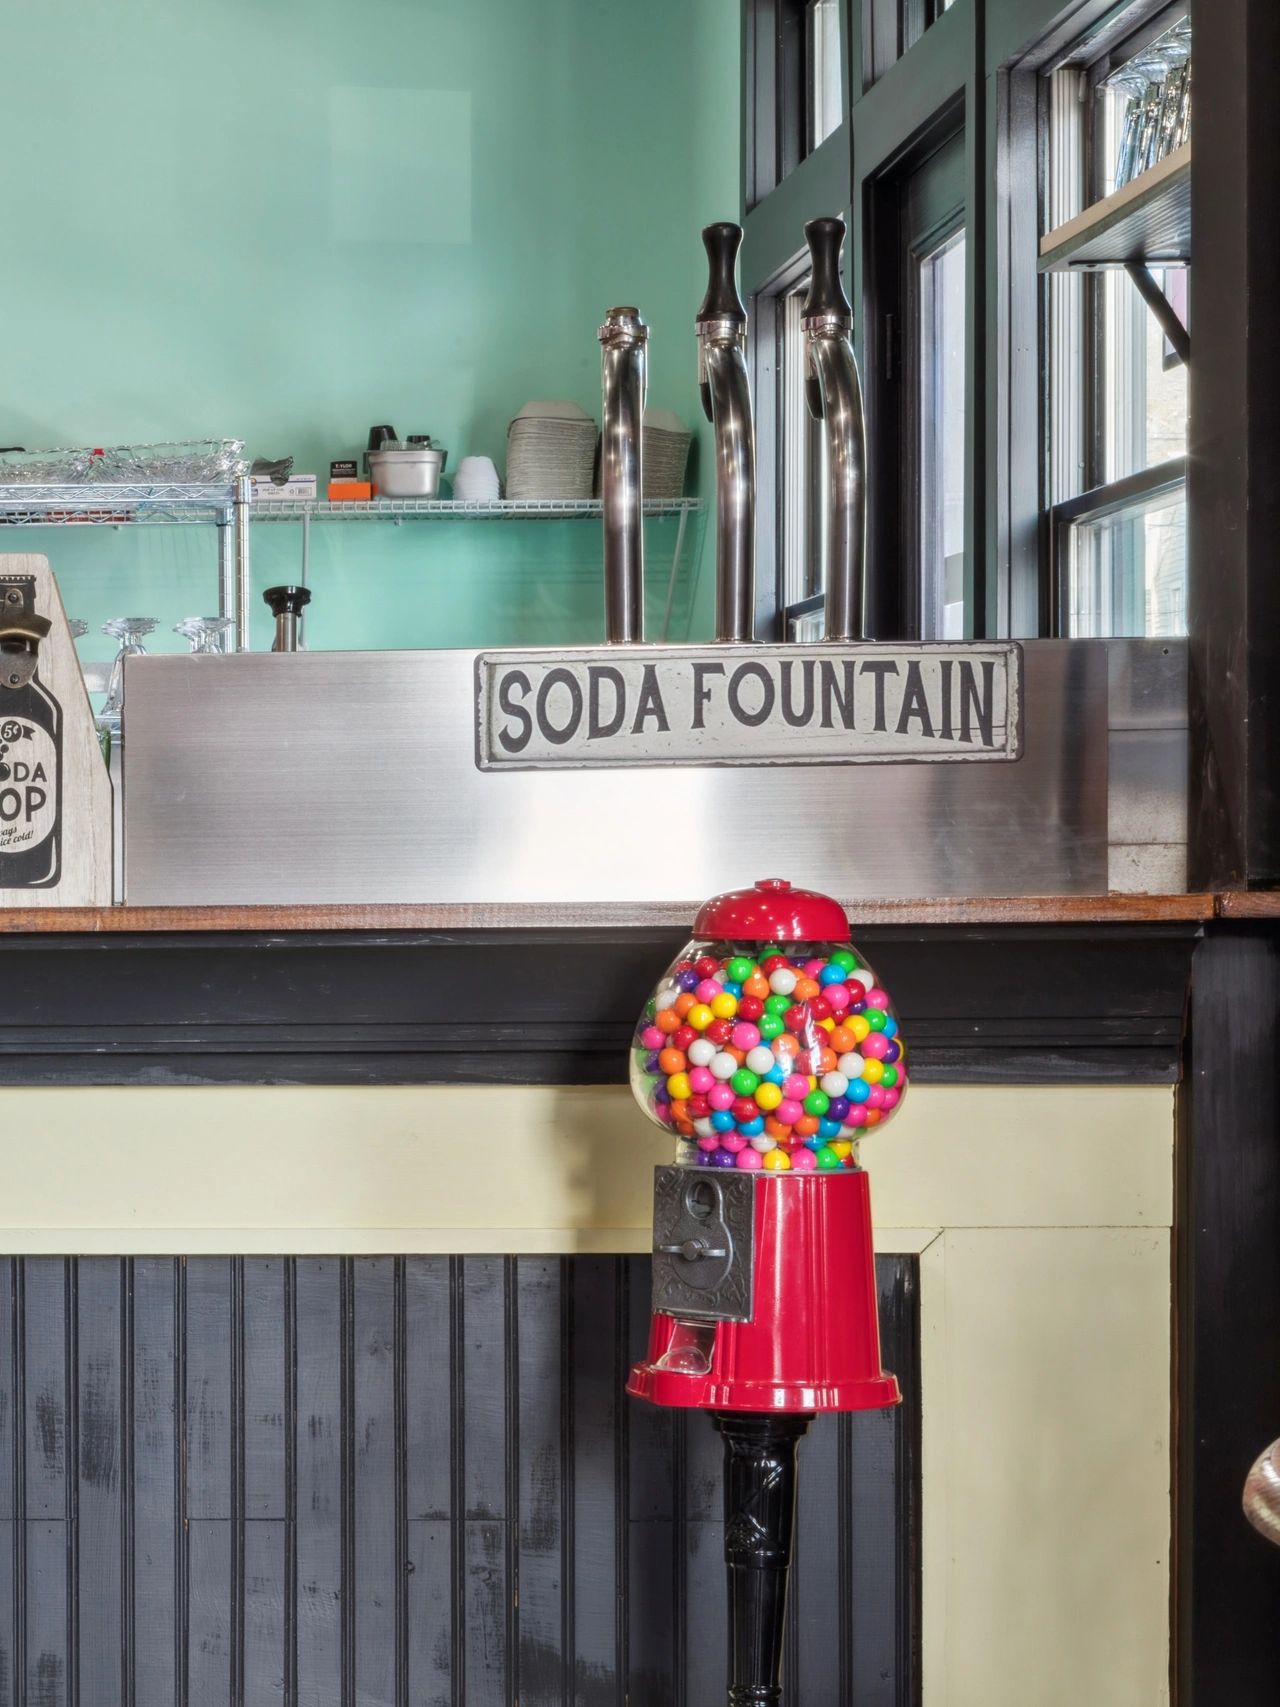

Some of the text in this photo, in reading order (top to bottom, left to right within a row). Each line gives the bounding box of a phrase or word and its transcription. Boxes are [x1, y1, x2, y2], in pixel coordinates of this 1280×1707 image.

[497, 660, 995, 754] SODA FOUNTAIN
[3, 725, 20, 740] 5¢
[0, 830, 34, 847] ice cold!
